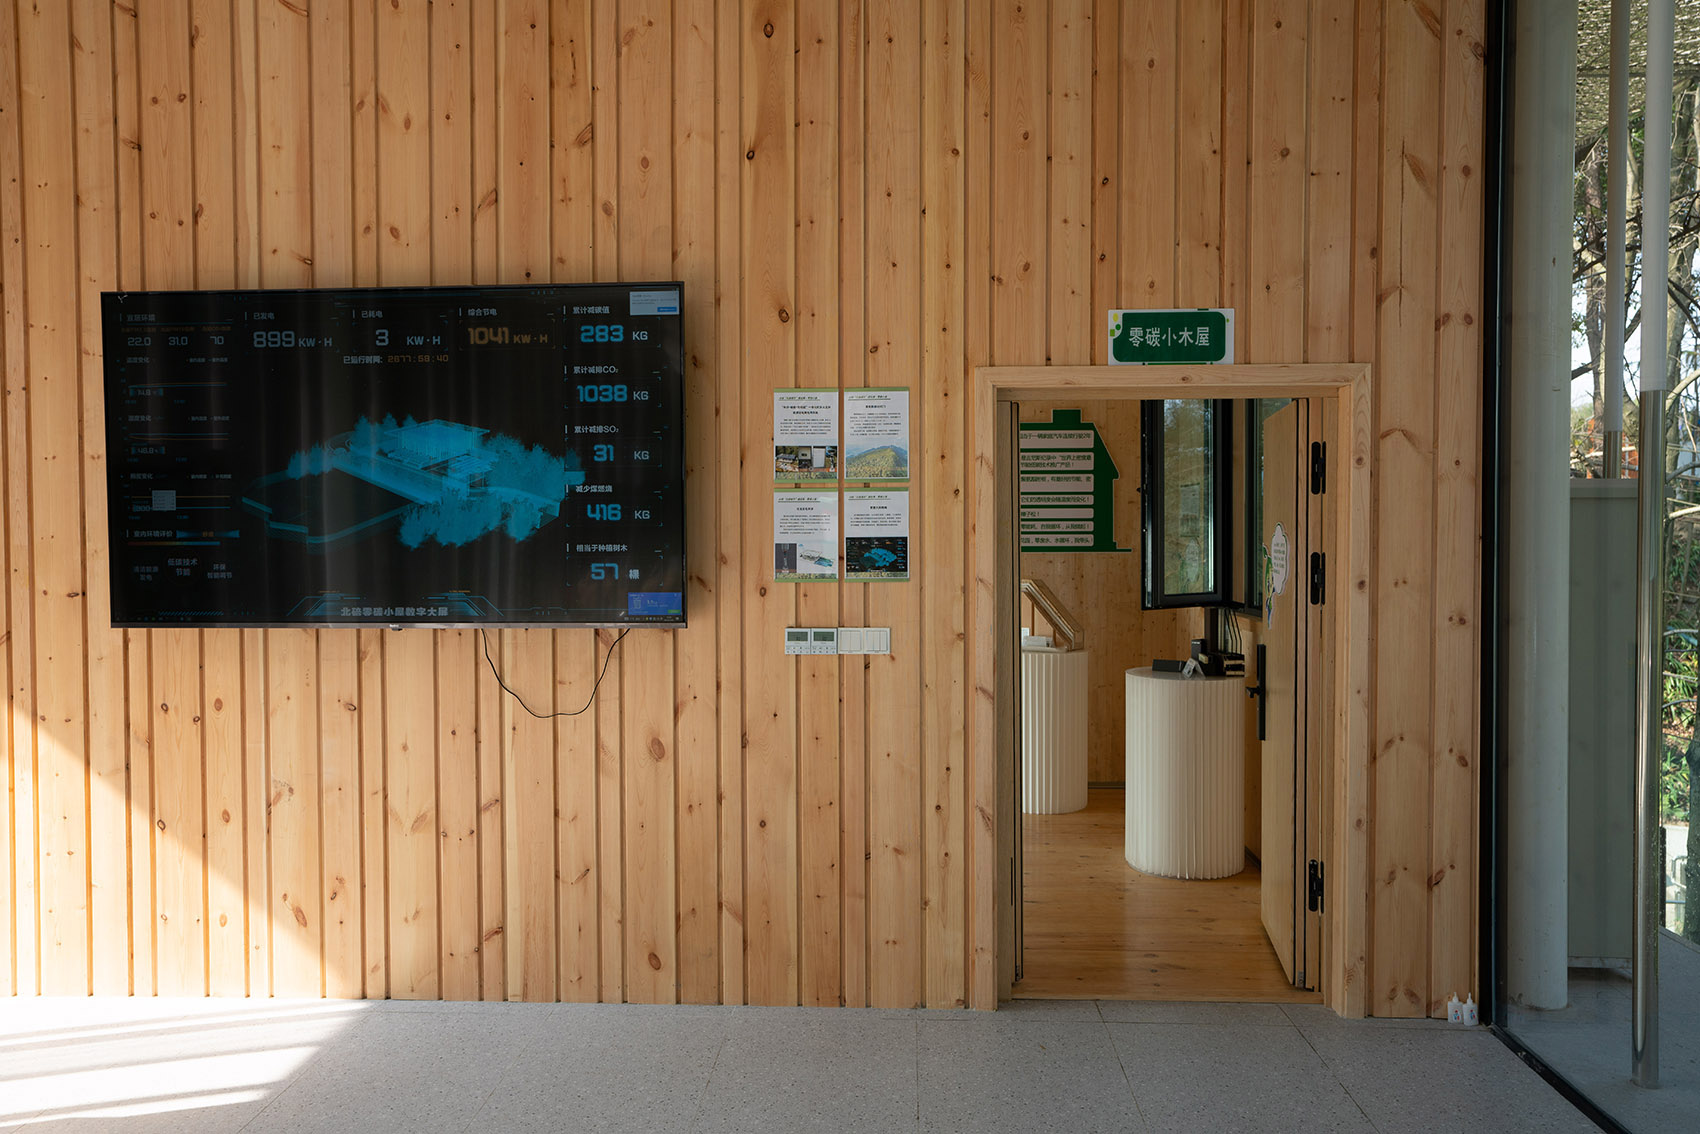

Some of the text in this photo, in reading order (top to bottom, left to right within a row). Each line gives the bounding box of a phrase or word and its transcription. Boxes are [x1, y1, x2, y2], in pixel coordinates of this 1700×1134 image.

[253, 312, 276, 320] 已发电
[361, 309, 384, 319] 已耗电
[467, 307, 498, 317] 综合节电
[127, 336, 152, 346] 22.0
[168, 336, 189, 346] 31.0
[253, 329, 296, 349] 899
[375, 328, 390, 347] 3
[467, 326, 509, 345] 1041
[580, 324, 649, 343] 283 KG
[1128, 326, 1210, 348] 零碳小木屋
[576, 384, 649, 403] 1038 KG
[593, 443, 650, 462] 31 KG
[586, 503, 651, 521] 416 KG
[576, 544, 628, 553] 相当于种植树木
[591, 562, 619, 580] 57
